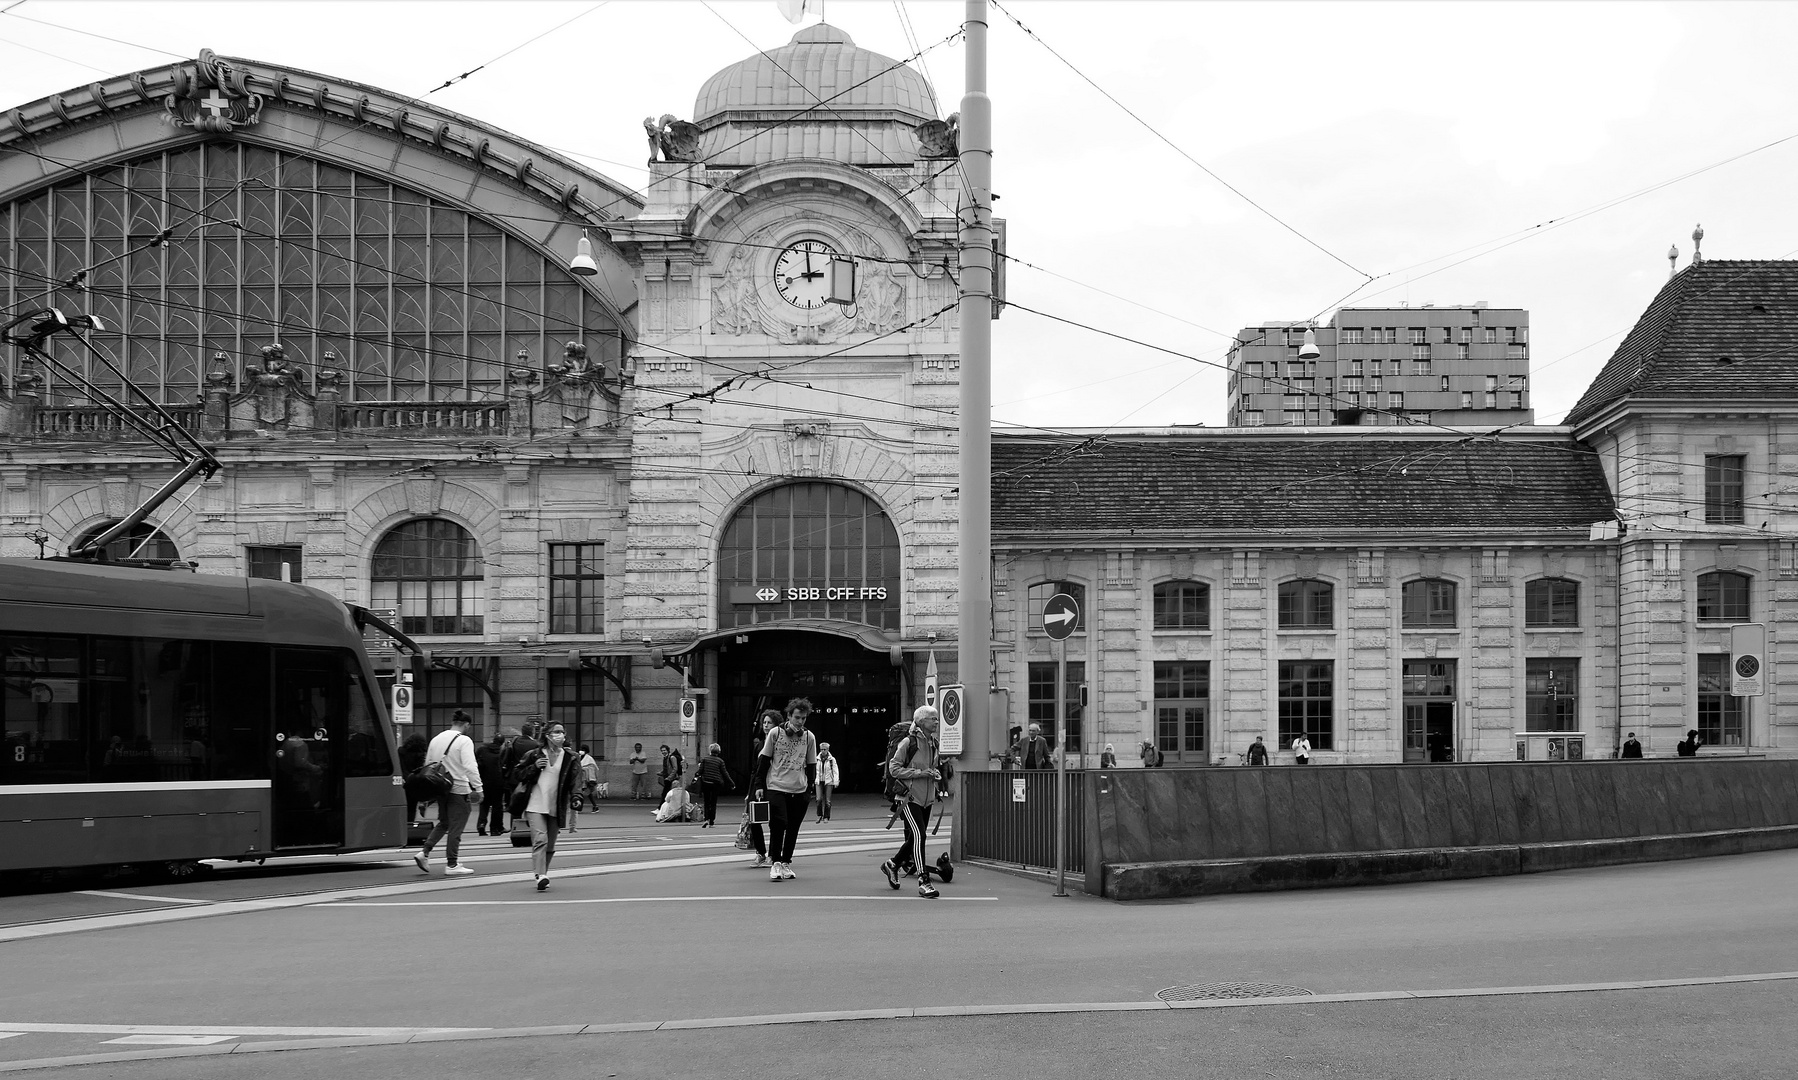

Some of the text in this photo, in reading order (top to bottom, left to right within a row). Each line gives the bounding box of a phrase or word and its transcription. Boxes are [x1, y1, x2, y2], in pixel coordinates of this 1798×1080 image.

[787, 587, 887, 600] SBB CFF FFS
[14, 745, 25, 762] 8
